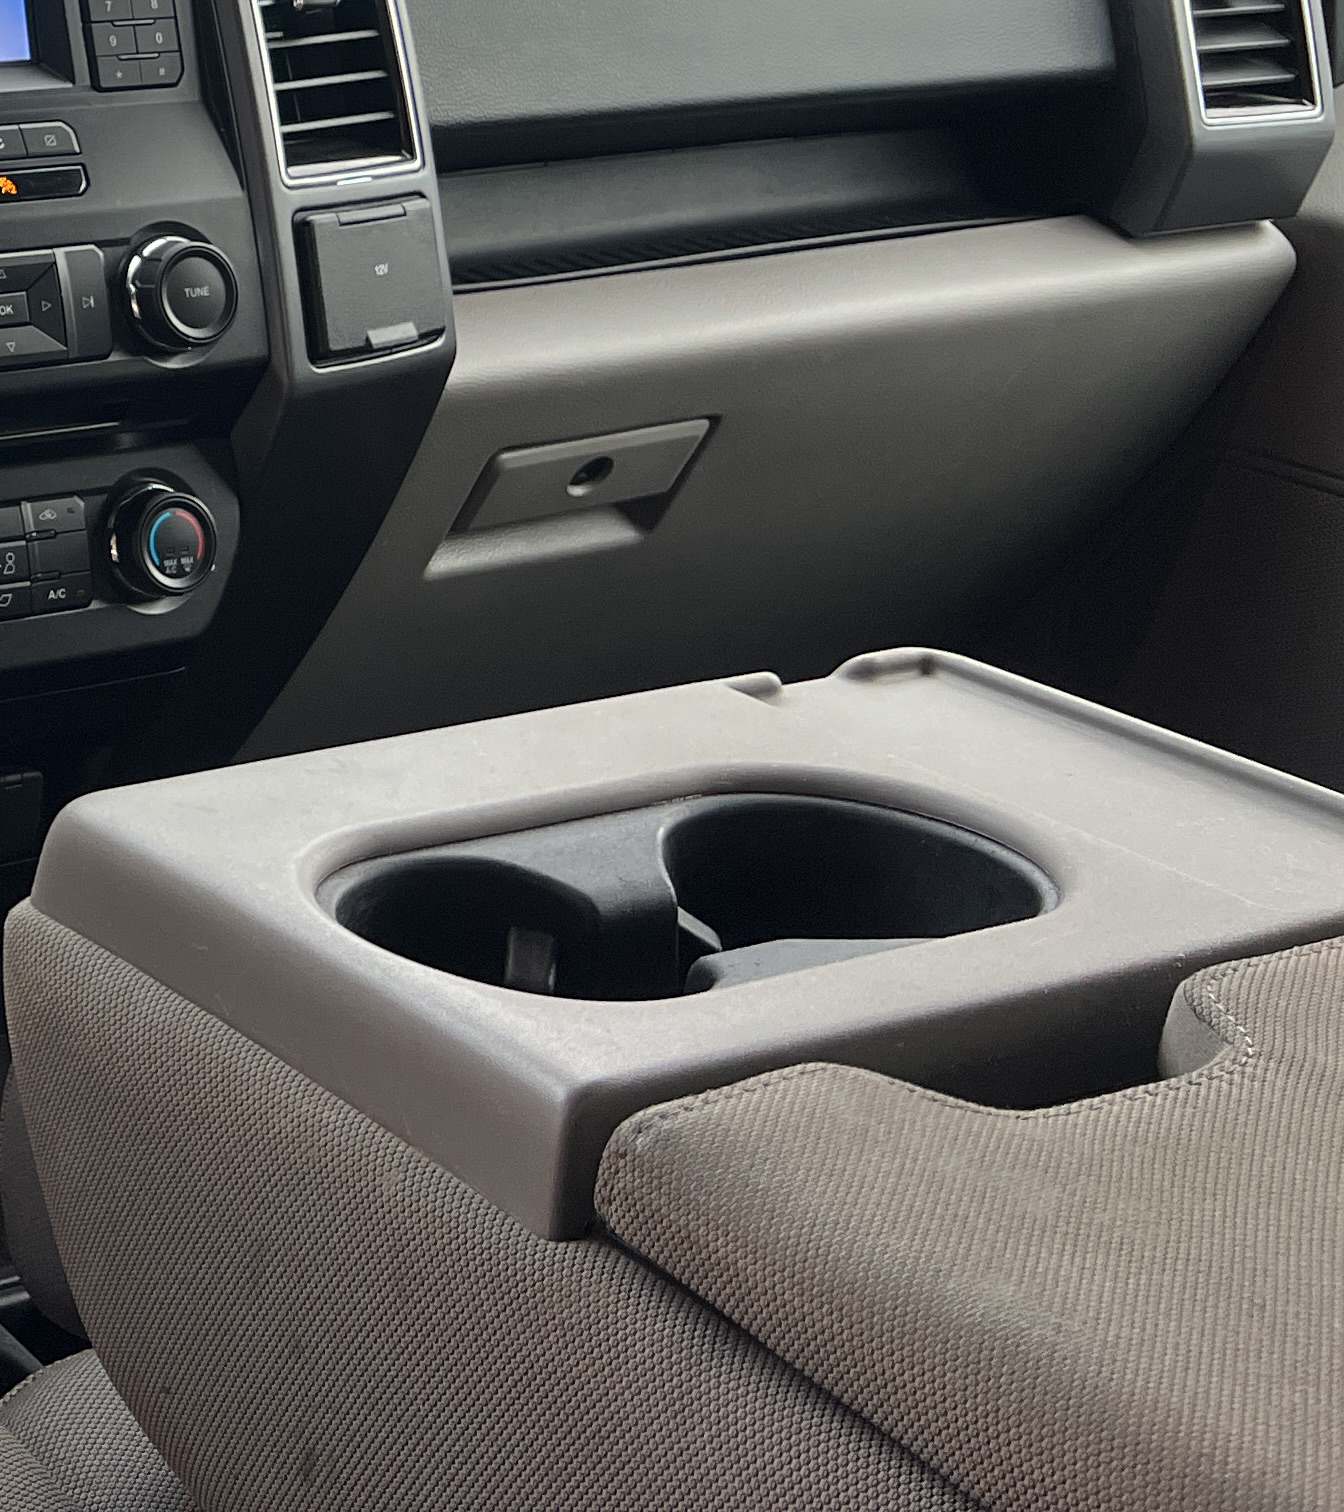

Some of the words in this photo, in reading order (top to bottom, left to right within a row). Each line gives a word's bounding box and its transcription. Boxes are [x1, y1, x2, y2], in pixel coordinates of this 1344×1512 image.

[104, 0, 112, 12] 7
[109, 35, 117, 47] 9
[155, 31, 163, 44] 0
[374, 262, 389, 276] 12V
[183, 286, 210, 298] TUNE
[47, 588, 67, 600] A/C
